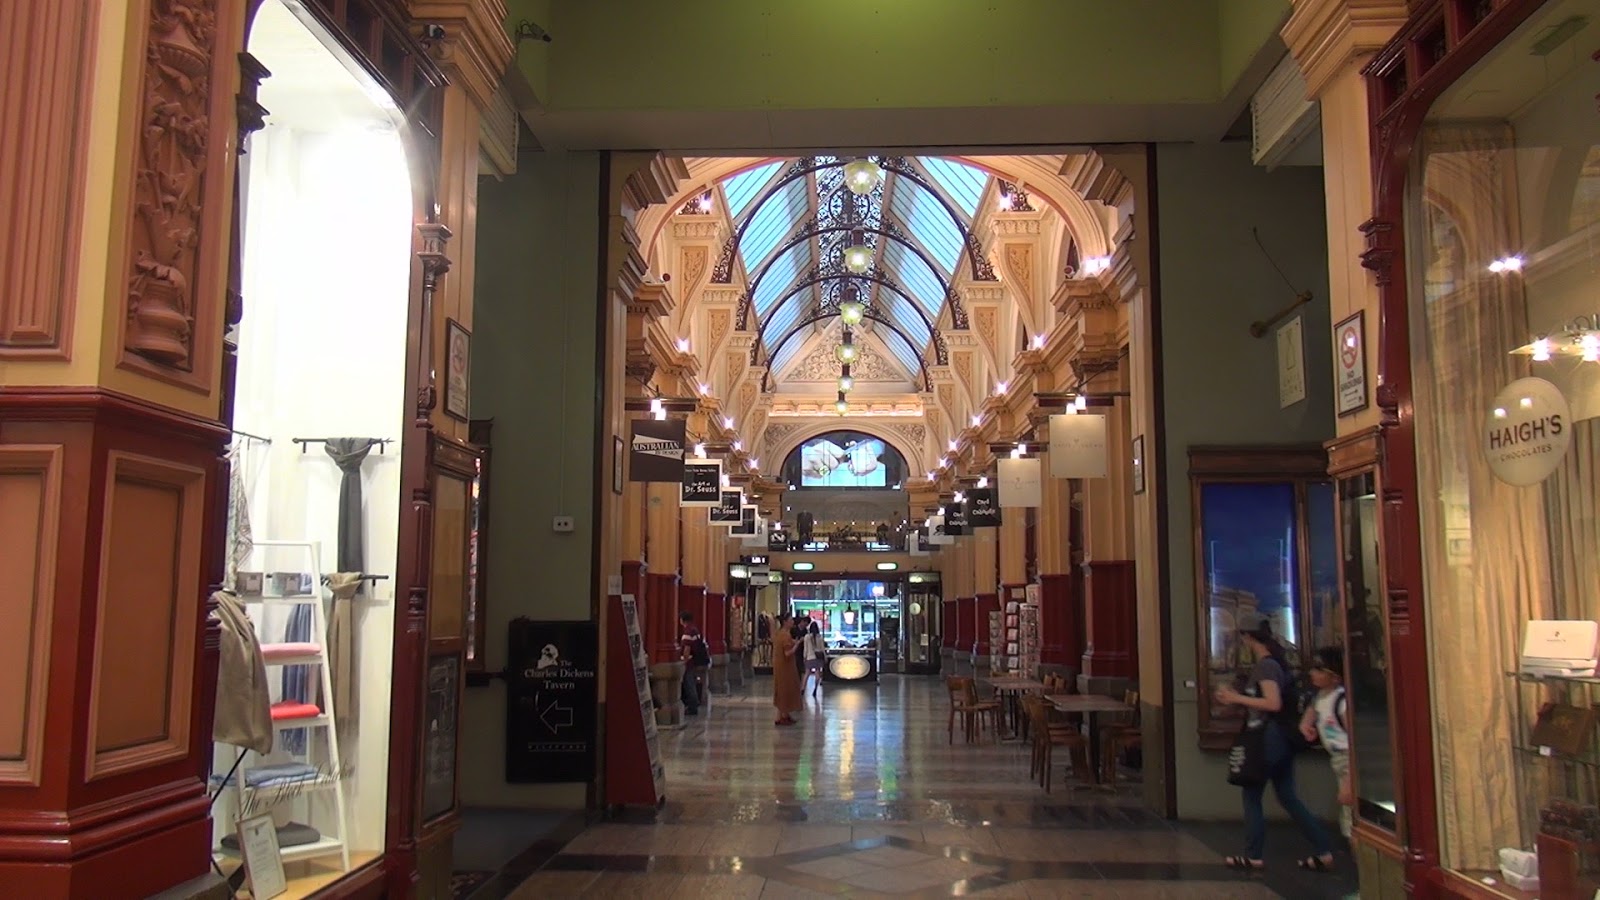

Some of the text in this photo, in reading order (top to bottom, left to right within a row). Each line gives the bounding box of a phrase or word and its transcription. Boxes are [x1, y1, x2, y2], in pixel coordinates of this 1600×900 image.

[1489, 414, 1562, 450] HAIGH'S
[631, 442, 680, 452] AUSTRALIAN
[1500, 443, 1553, 462] CHOCOLATES
[685, 485, 717, 493] Dr. Seuss
[524, 669, 594, 678] Charles Dickens
[544, 680, 575, 689] Tavern
[266, 779, 305, 806] Block
